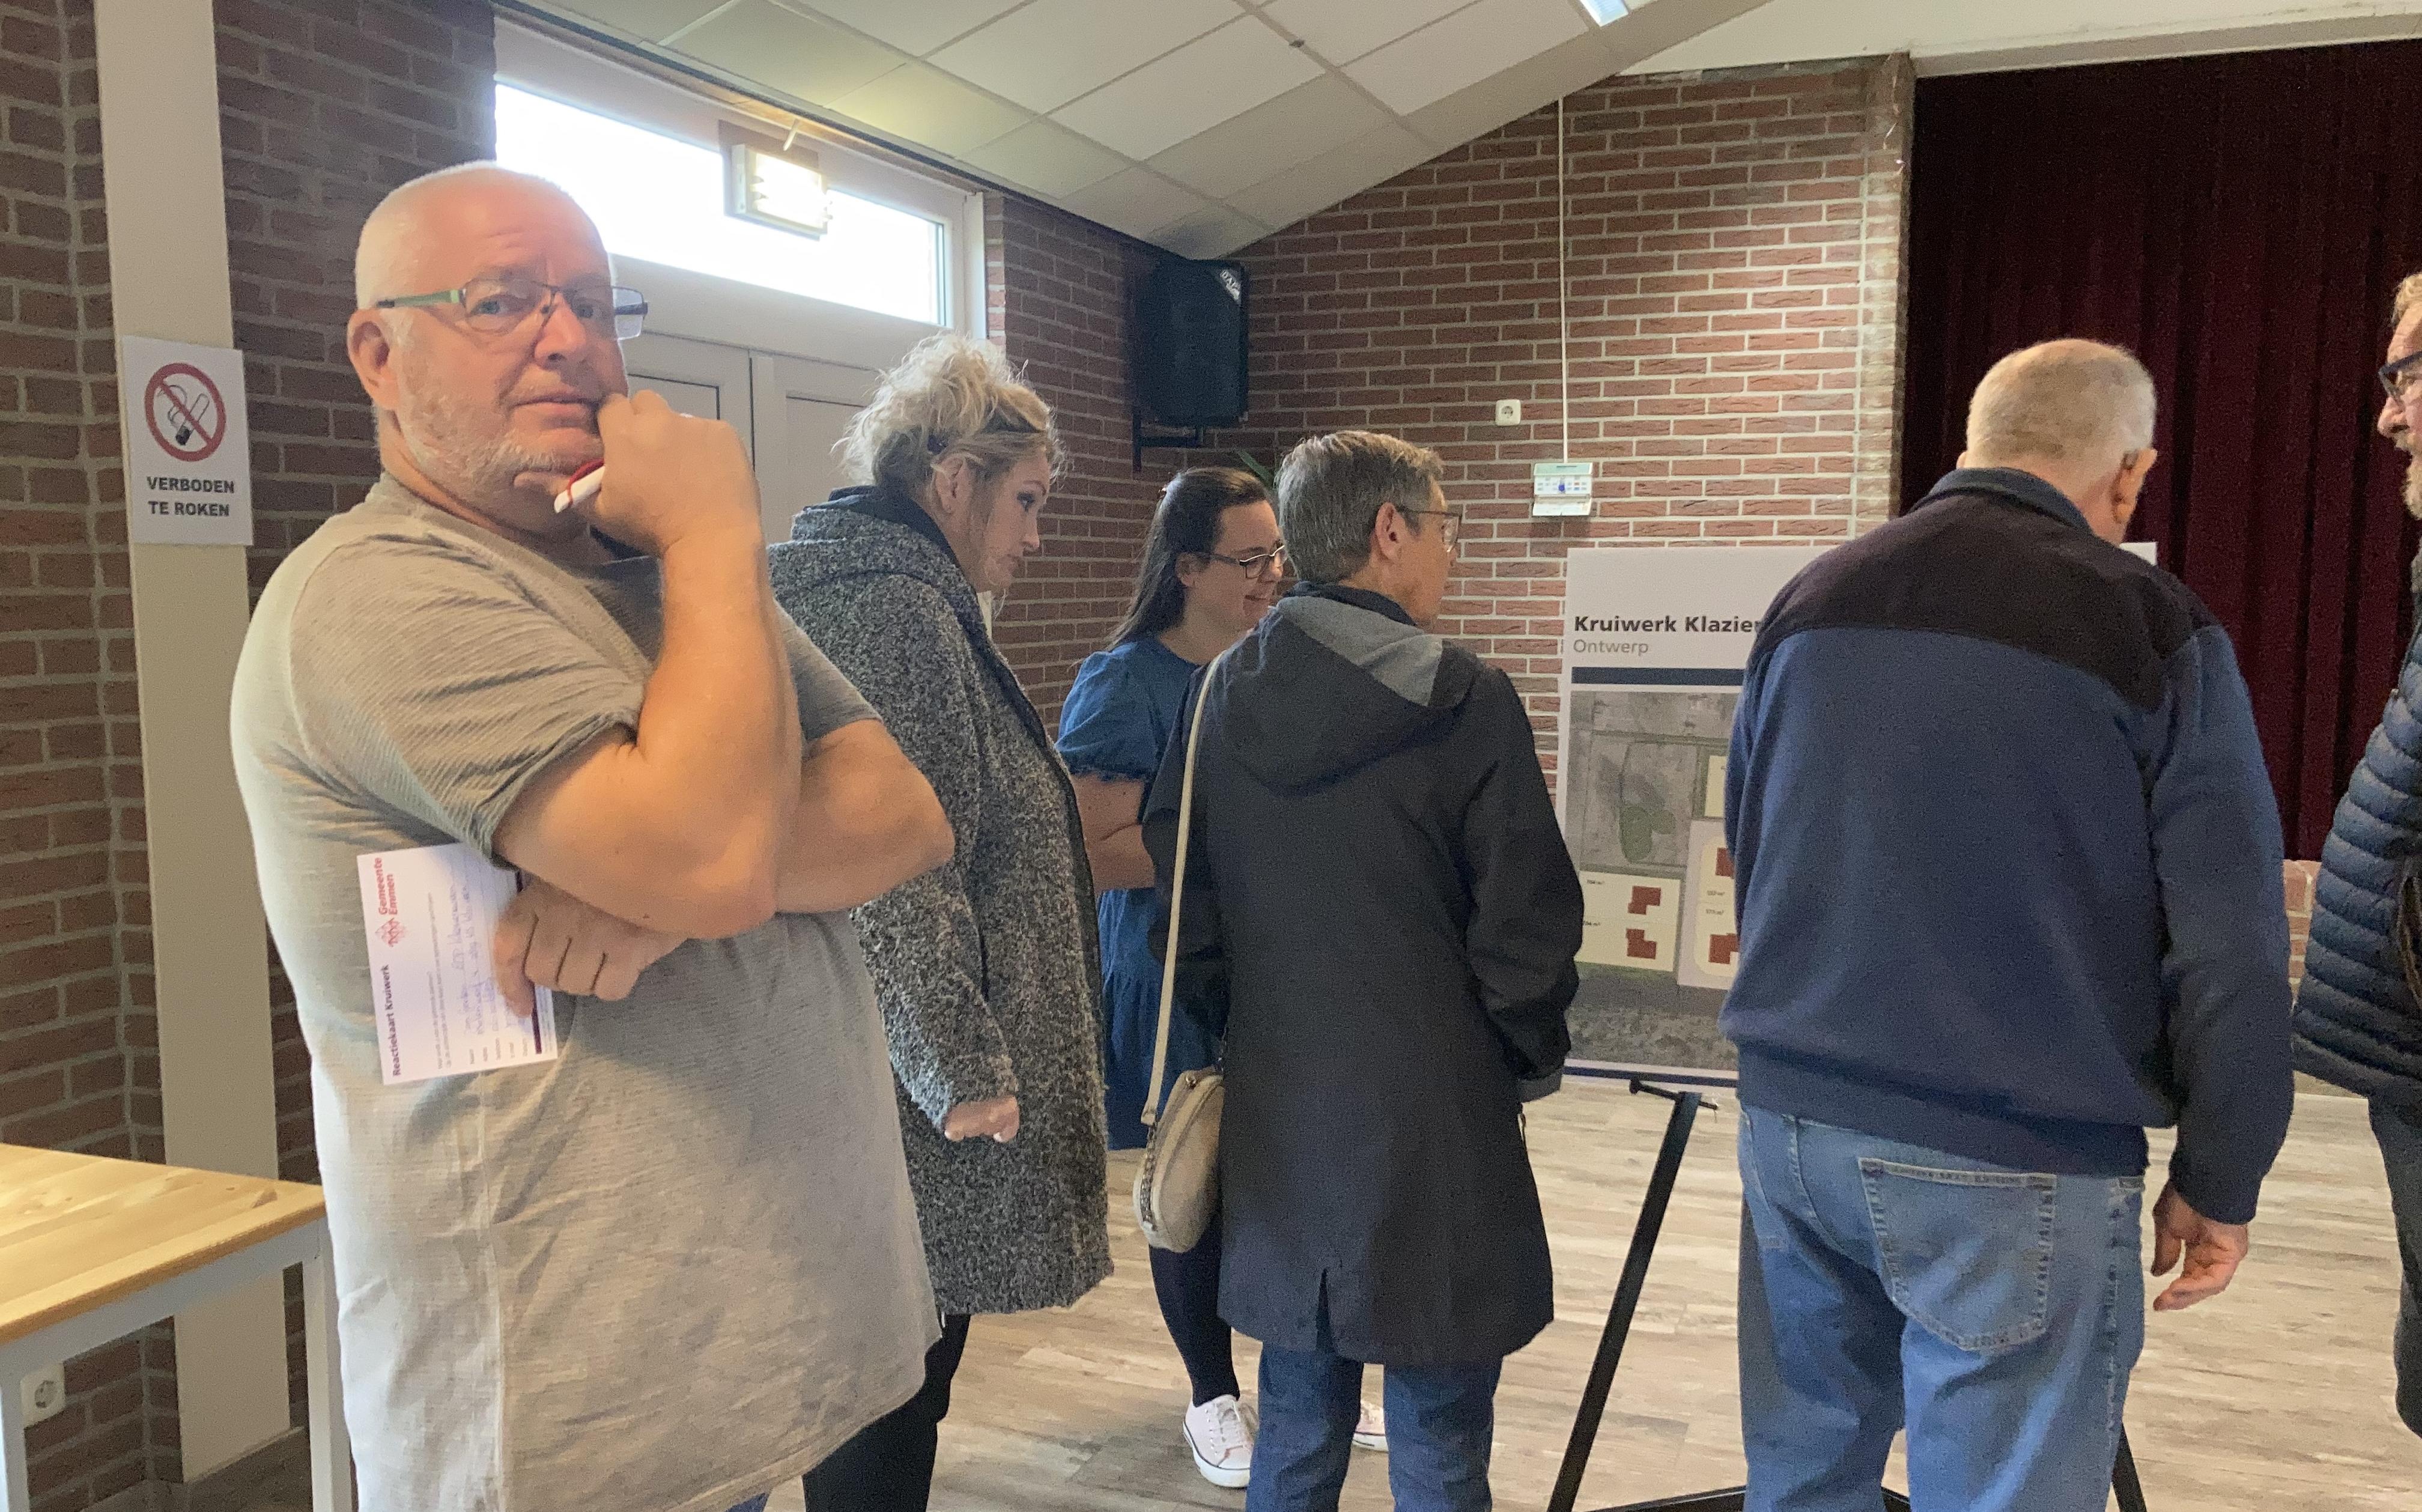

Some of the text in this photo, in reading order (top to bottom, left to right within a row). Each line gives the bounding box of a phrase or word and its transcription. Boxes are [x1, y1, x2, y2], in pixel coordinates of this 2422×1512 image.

[147, 476, 234, 493] VERBODEN
[148, 500, 229, 517] TE ROKEN
[1575, 616, 1677, 632] Kruiwerk
[1573, 639, 1649, 657] Ontwerp
[374, 857, 387, 915] Gemeente
[387, 874, 398, 915] Emmen
[381, 964, 401, 1076] Reactiekaart Kruiwerk
